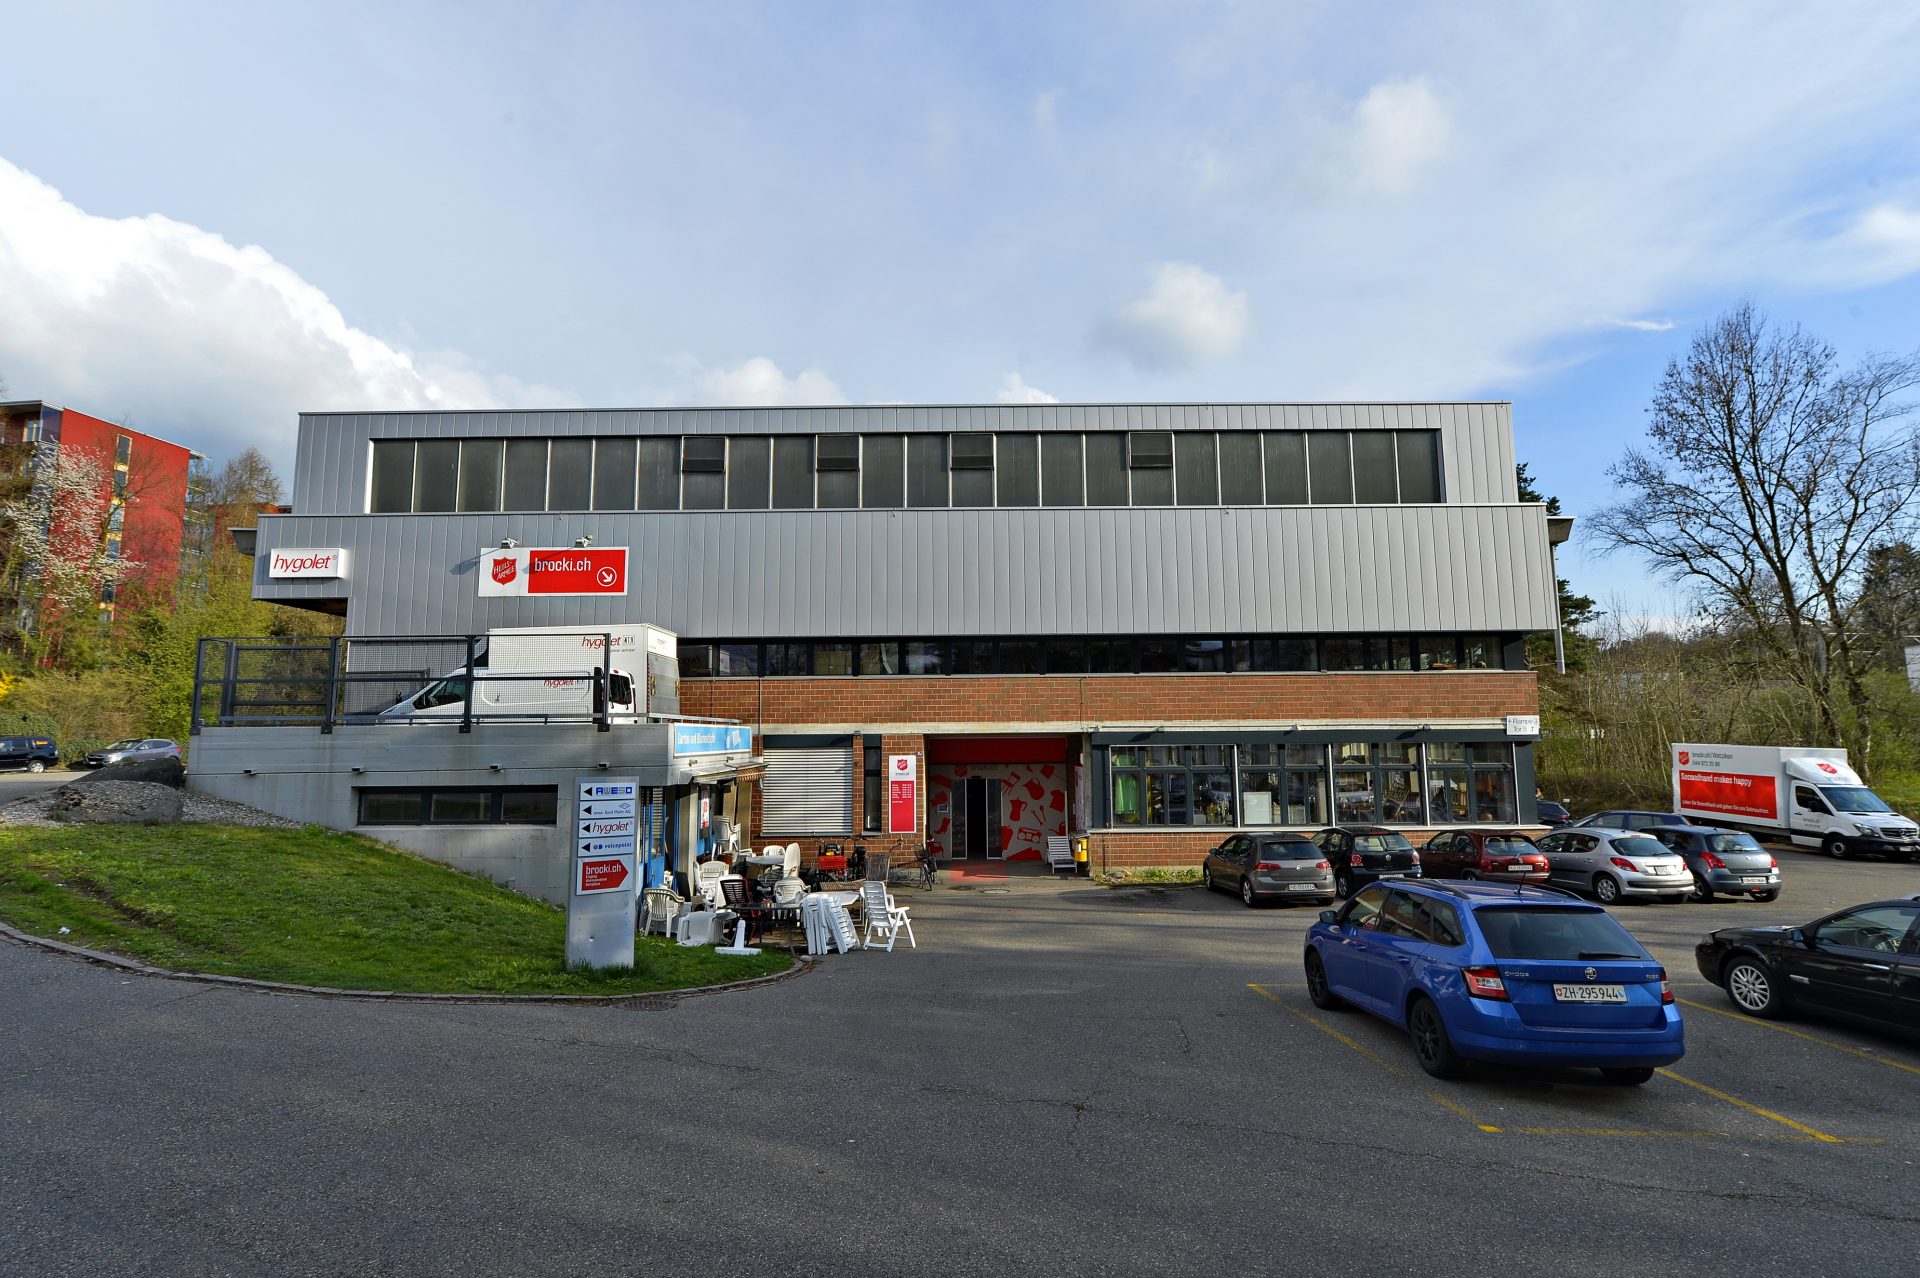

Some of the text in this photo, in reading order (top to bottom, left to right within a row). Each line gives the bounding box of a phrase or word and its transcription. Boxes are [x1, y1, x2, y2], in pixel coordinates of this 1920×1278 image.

[534, 557, 591, 572] brocki.ch
[582, 636, 621, 650] hygoet
[1680, 772, 1752, 787] Secondhand makes happy
[592, 821, 629, 835] hygolet
[585, 863, 622, 875] brocki.ch
